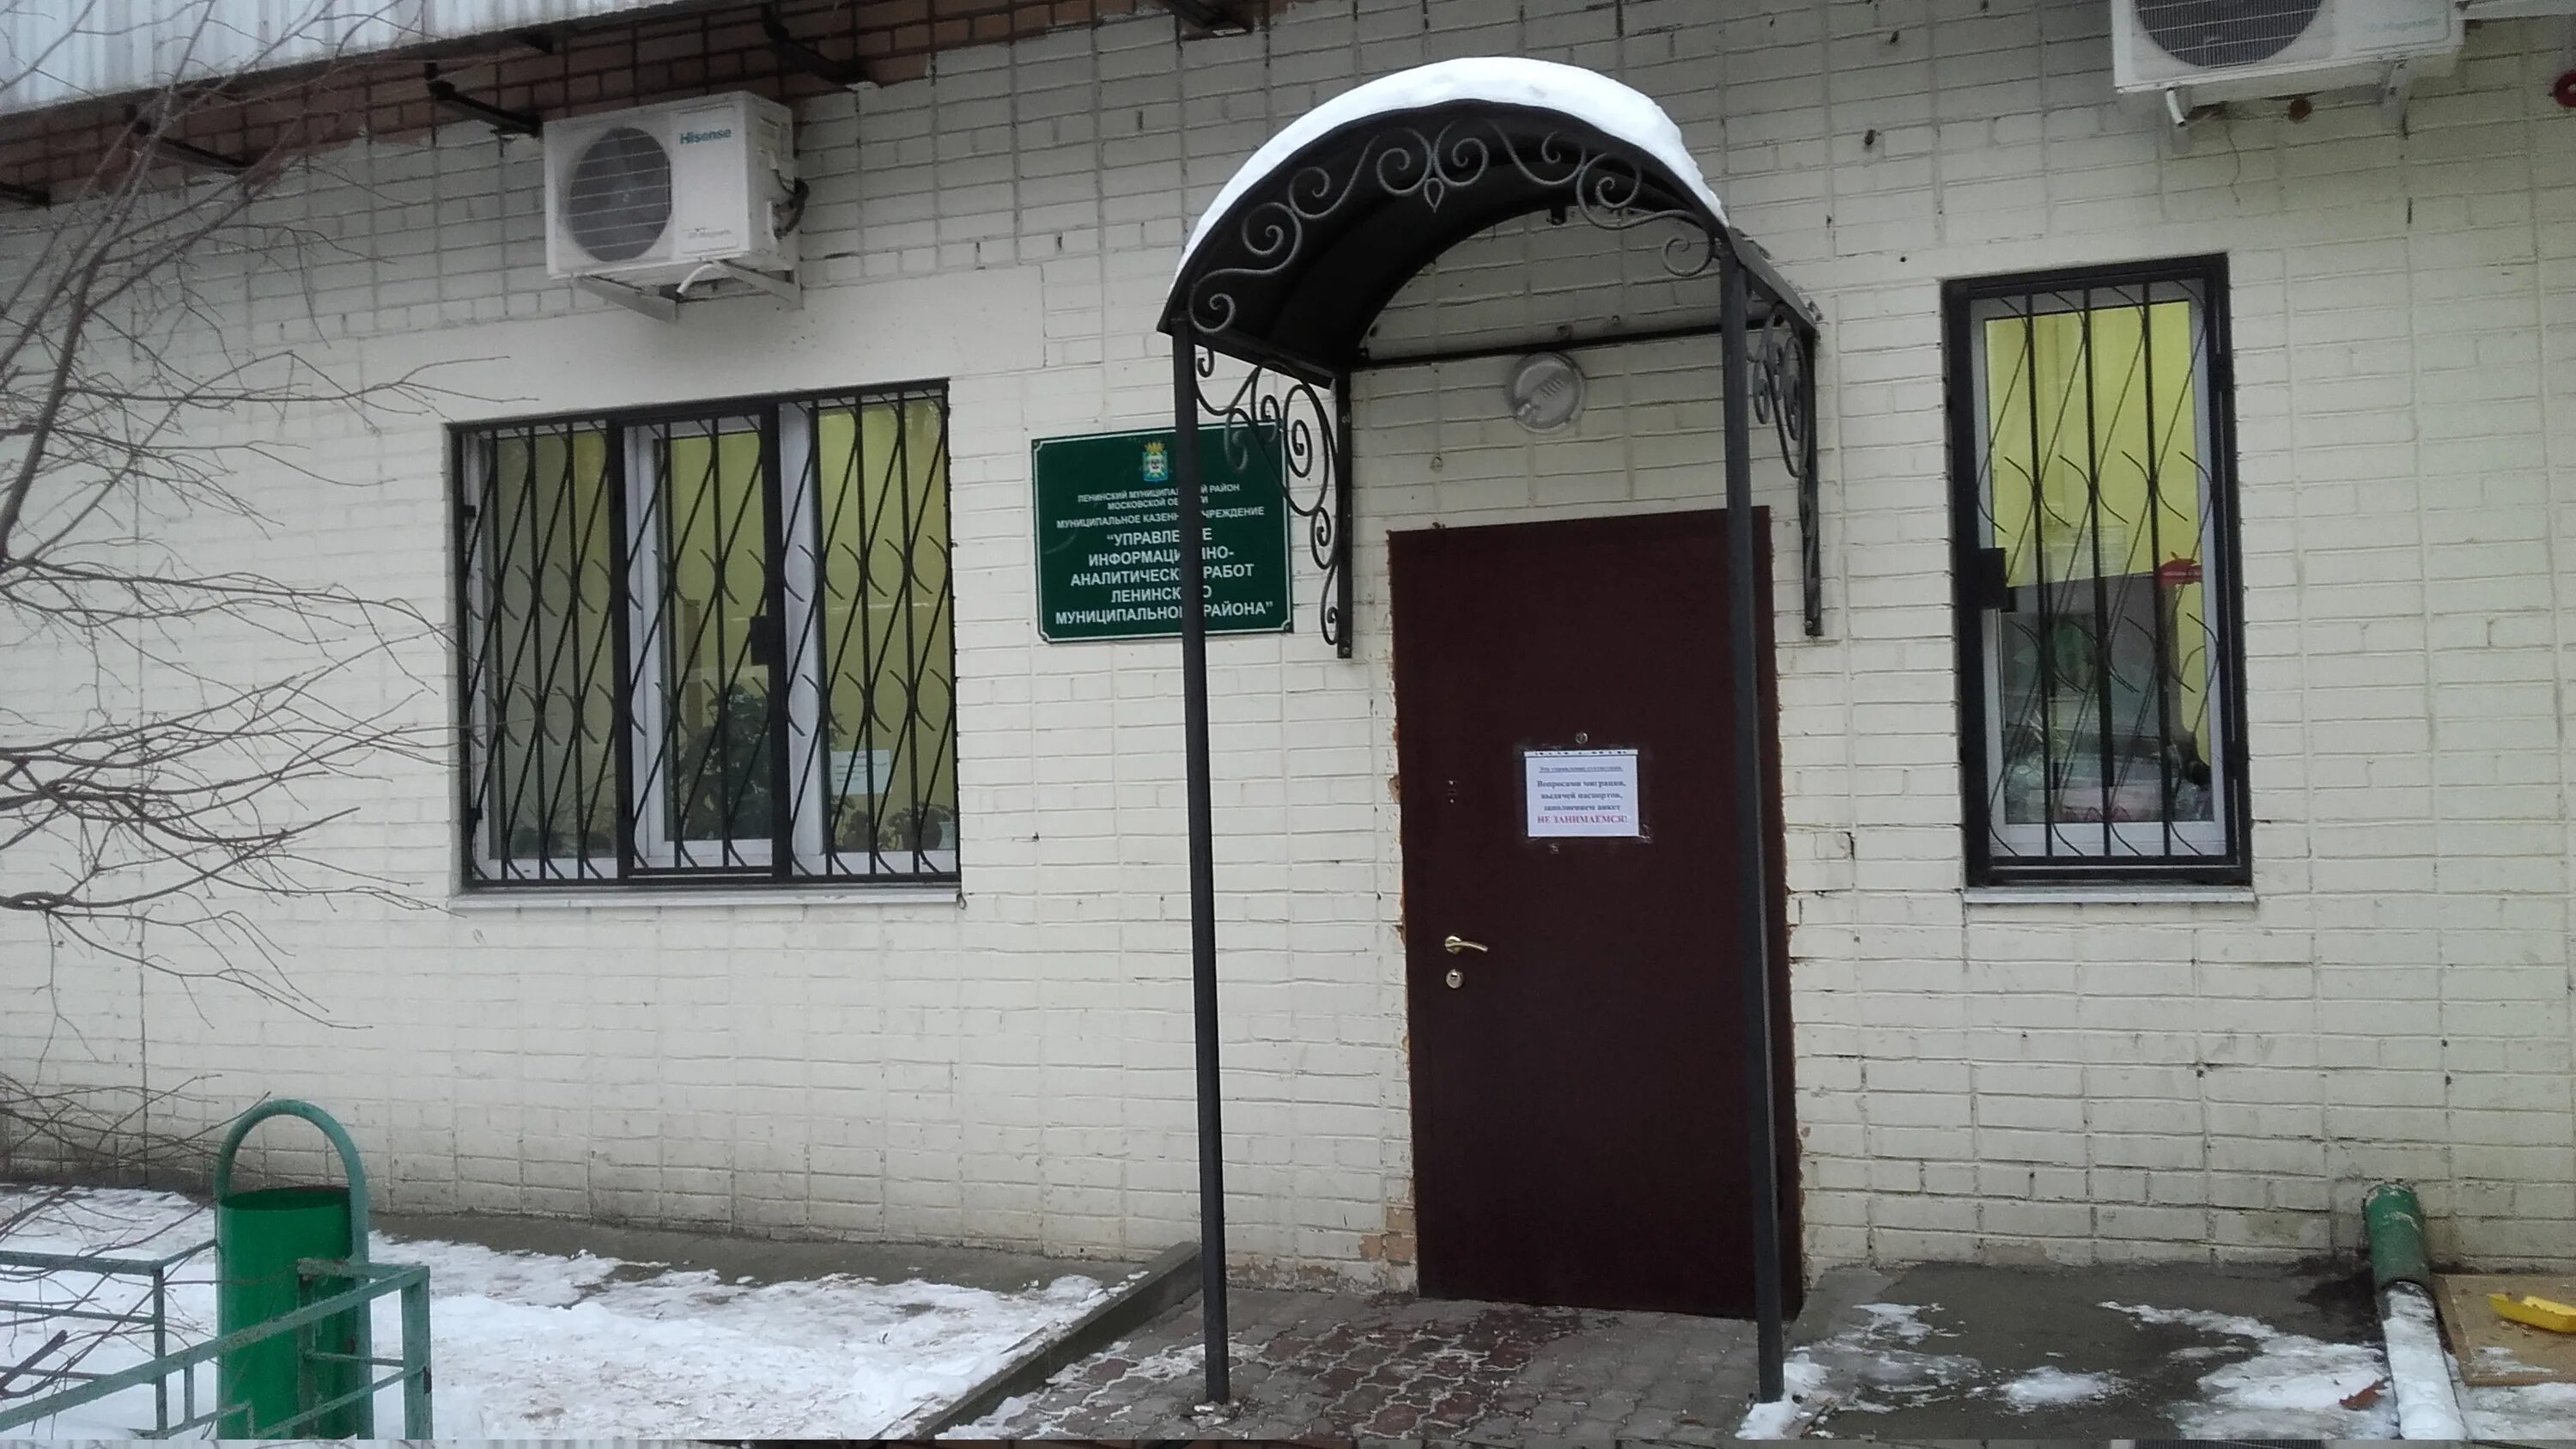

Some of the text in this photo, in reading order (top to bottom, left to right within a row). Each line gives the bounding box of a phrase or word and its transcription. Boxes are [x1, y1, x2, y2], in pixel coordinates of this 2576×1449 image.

[679, 129, 732, 144] Hisense
[1078, 484, 1240, 502] ЛЕНИНСКИЙ МУНИЦИПАЙ РАЙОН
[1107, 498, 1165, 510] МОСКОВСКОЙ
[1056, 515, 1141, 529] МУНИЦИПАЛЬНОЕ
[1200, 507, 1264, 519] ЧРЕЖДЕНИЕ
[1107, 527, 1212, 546] “УПРАВЛЕЕ
[1070, 563, 1255, 587] АНАЛИТИЧЕСК РАБОТ
[1111, 585, 1212, 603] ЛЕНИНСКО
[1055, 606, 1182, 625] МУНИЦИПАЛЬНО
[1537, 815, 1628, 824] НЕ ЗАНИМАЕМСЯ!
